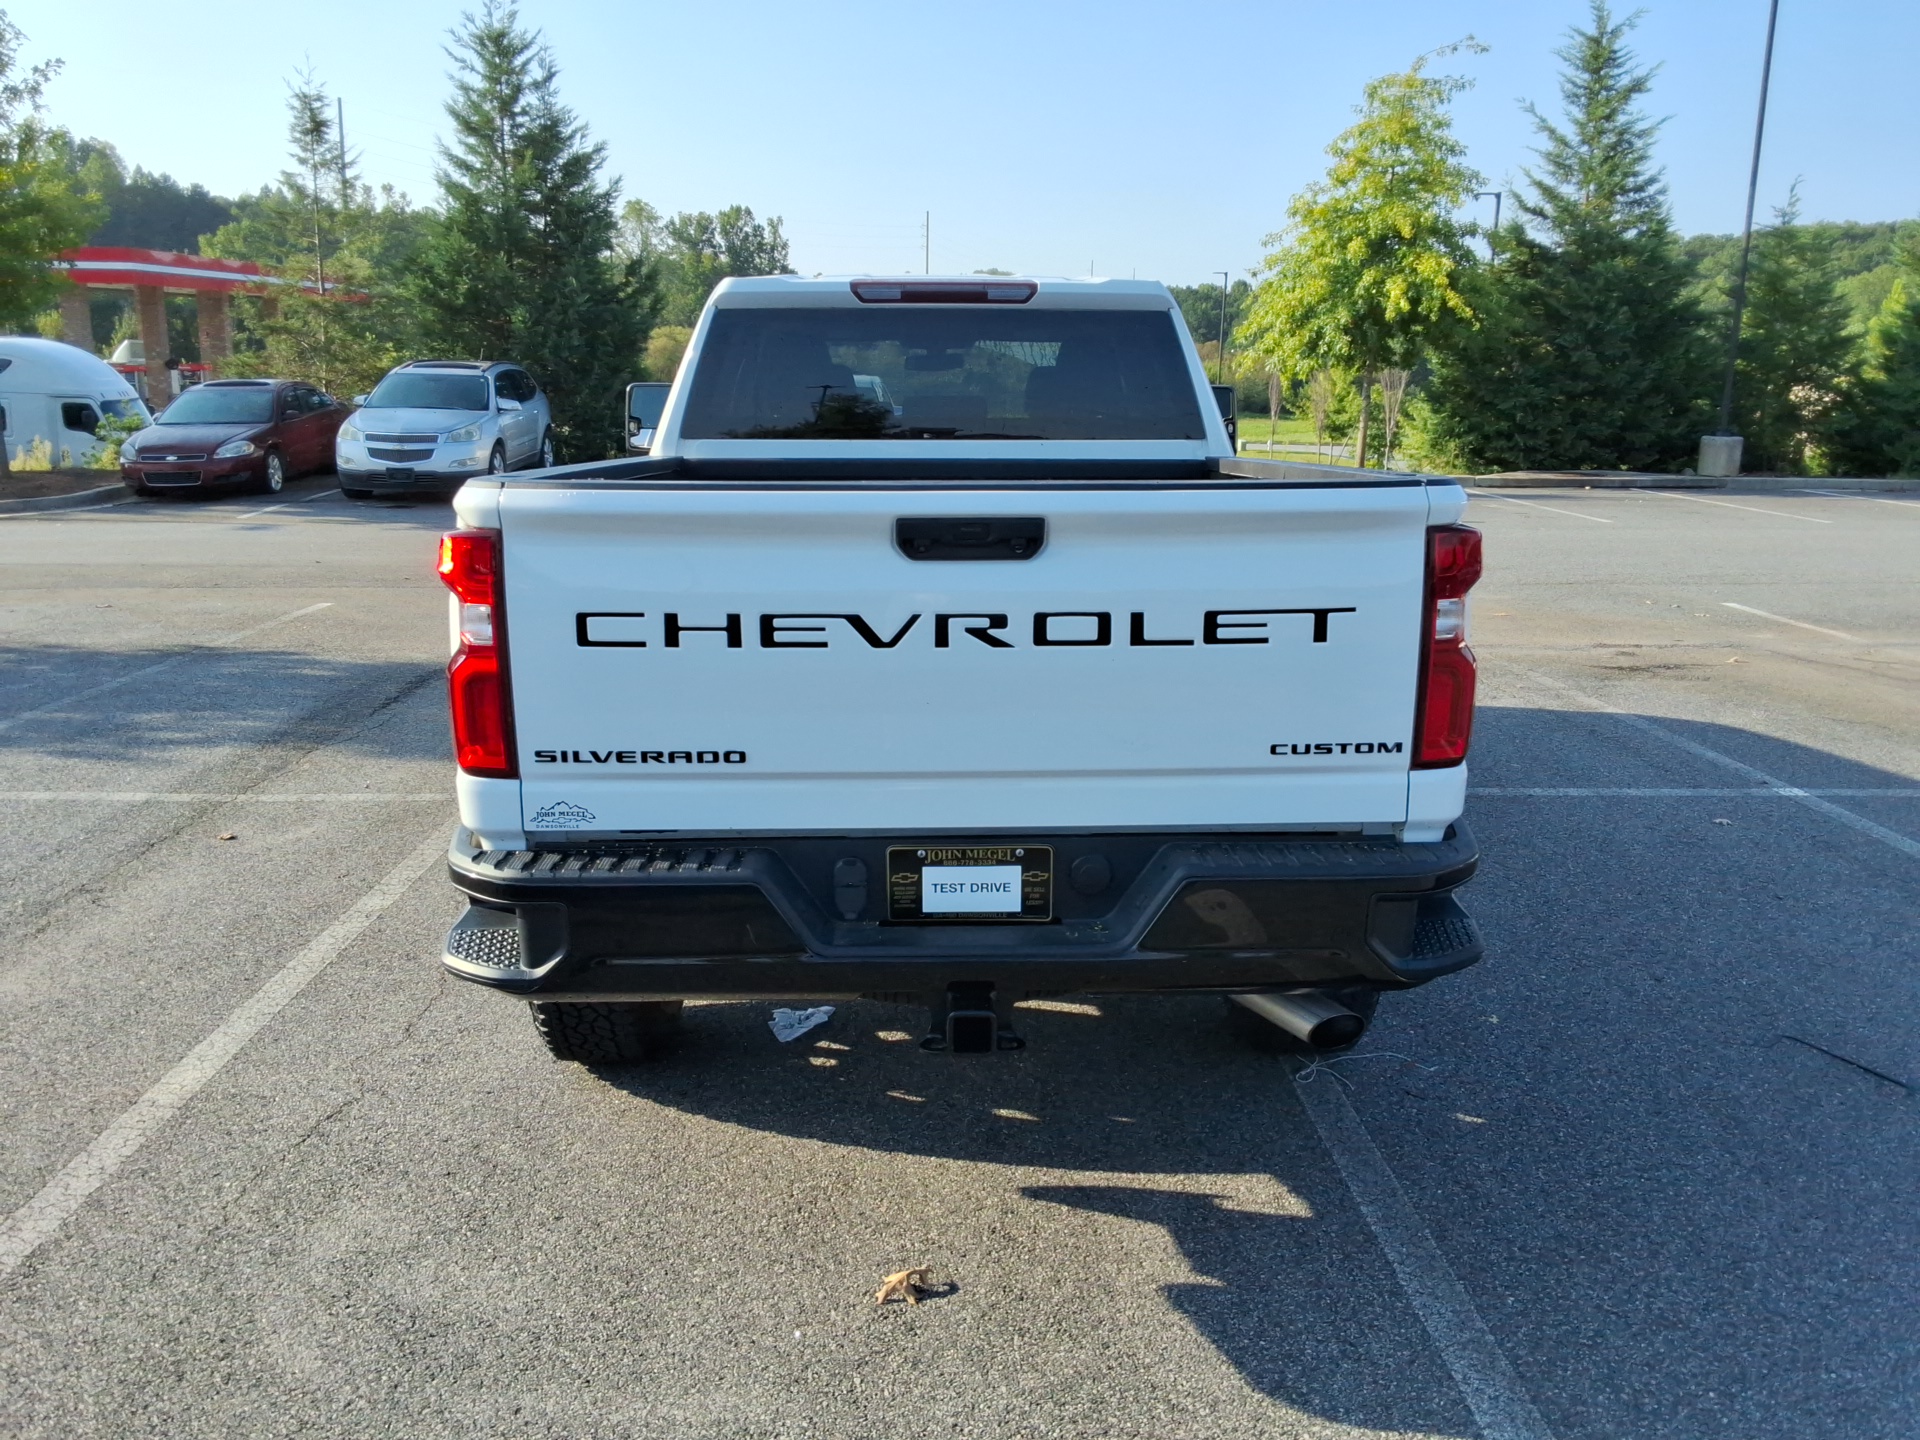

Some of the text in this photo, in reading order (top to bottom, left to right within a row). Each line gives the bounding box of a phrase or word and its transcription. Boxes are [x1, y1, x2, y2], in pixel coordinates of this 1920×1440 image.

[576, 607, 1357, 649] CHEVROLET
[1270, 742, 1403, 755] CUSTOM
[534, 750, 747, 764] SILVERADO
[536, 811, 556, 820] JOHN
[925, 849, 1016, 864] JOHN MEGEL
[931, 882, 1012, 894] TEST DRIVE
